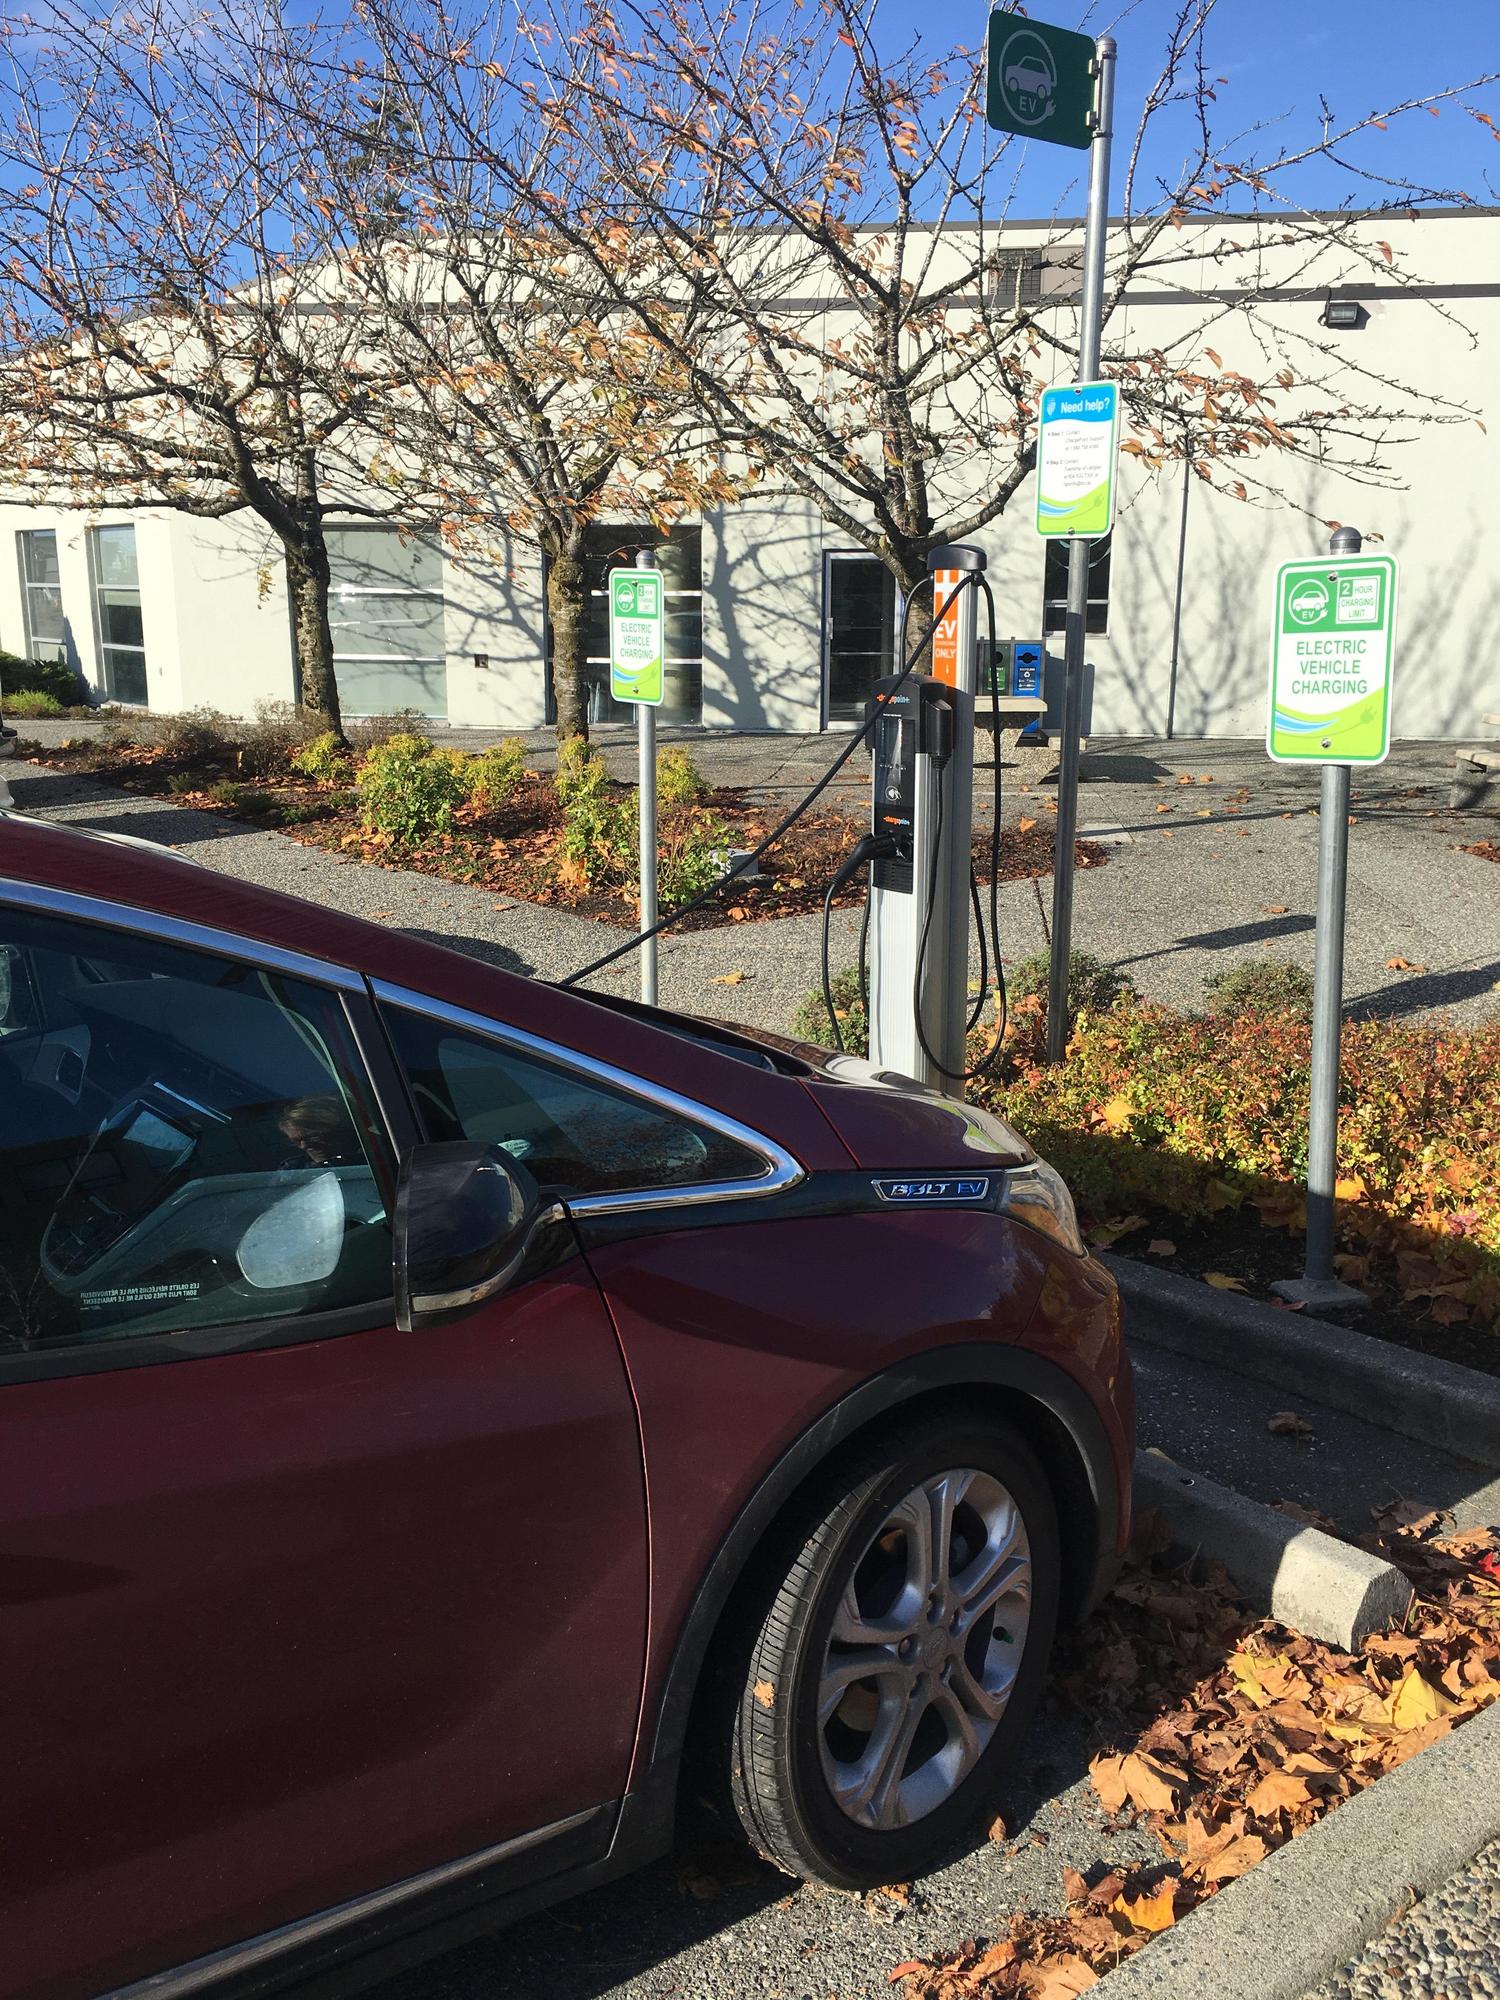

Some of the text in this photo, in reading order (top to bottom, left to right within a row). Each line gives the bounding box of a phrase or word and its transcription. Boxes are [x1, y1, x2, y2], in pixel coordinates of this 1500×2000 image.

[1019, 96, 1037, 113] EV
[1060, 396, 1110, 414] Need help?
[1342, 582, 1373, 596] 2 HOUR
[1340, 596, 1374, 607] CHARGING
[1302, 610, 1315, 619] EV
[1348, 609, 1365, 618] LIMIT
[621, 622, 652, 634] ELECTRIC
[934, 620, 956, 639] EV
[623, 635, 650, 646] VEHICLE
[620, 648, 654, 659] CHARGING
[935, 648, 956, 658] ONLY
[1296, 640, 1367, 656] ELECTRIC
[1300, 660, 1360, 675] VEHICLE
[1292, 679, 1368, 695] CHARGING
[890, 1182, 982, 1196] BOLT EV
